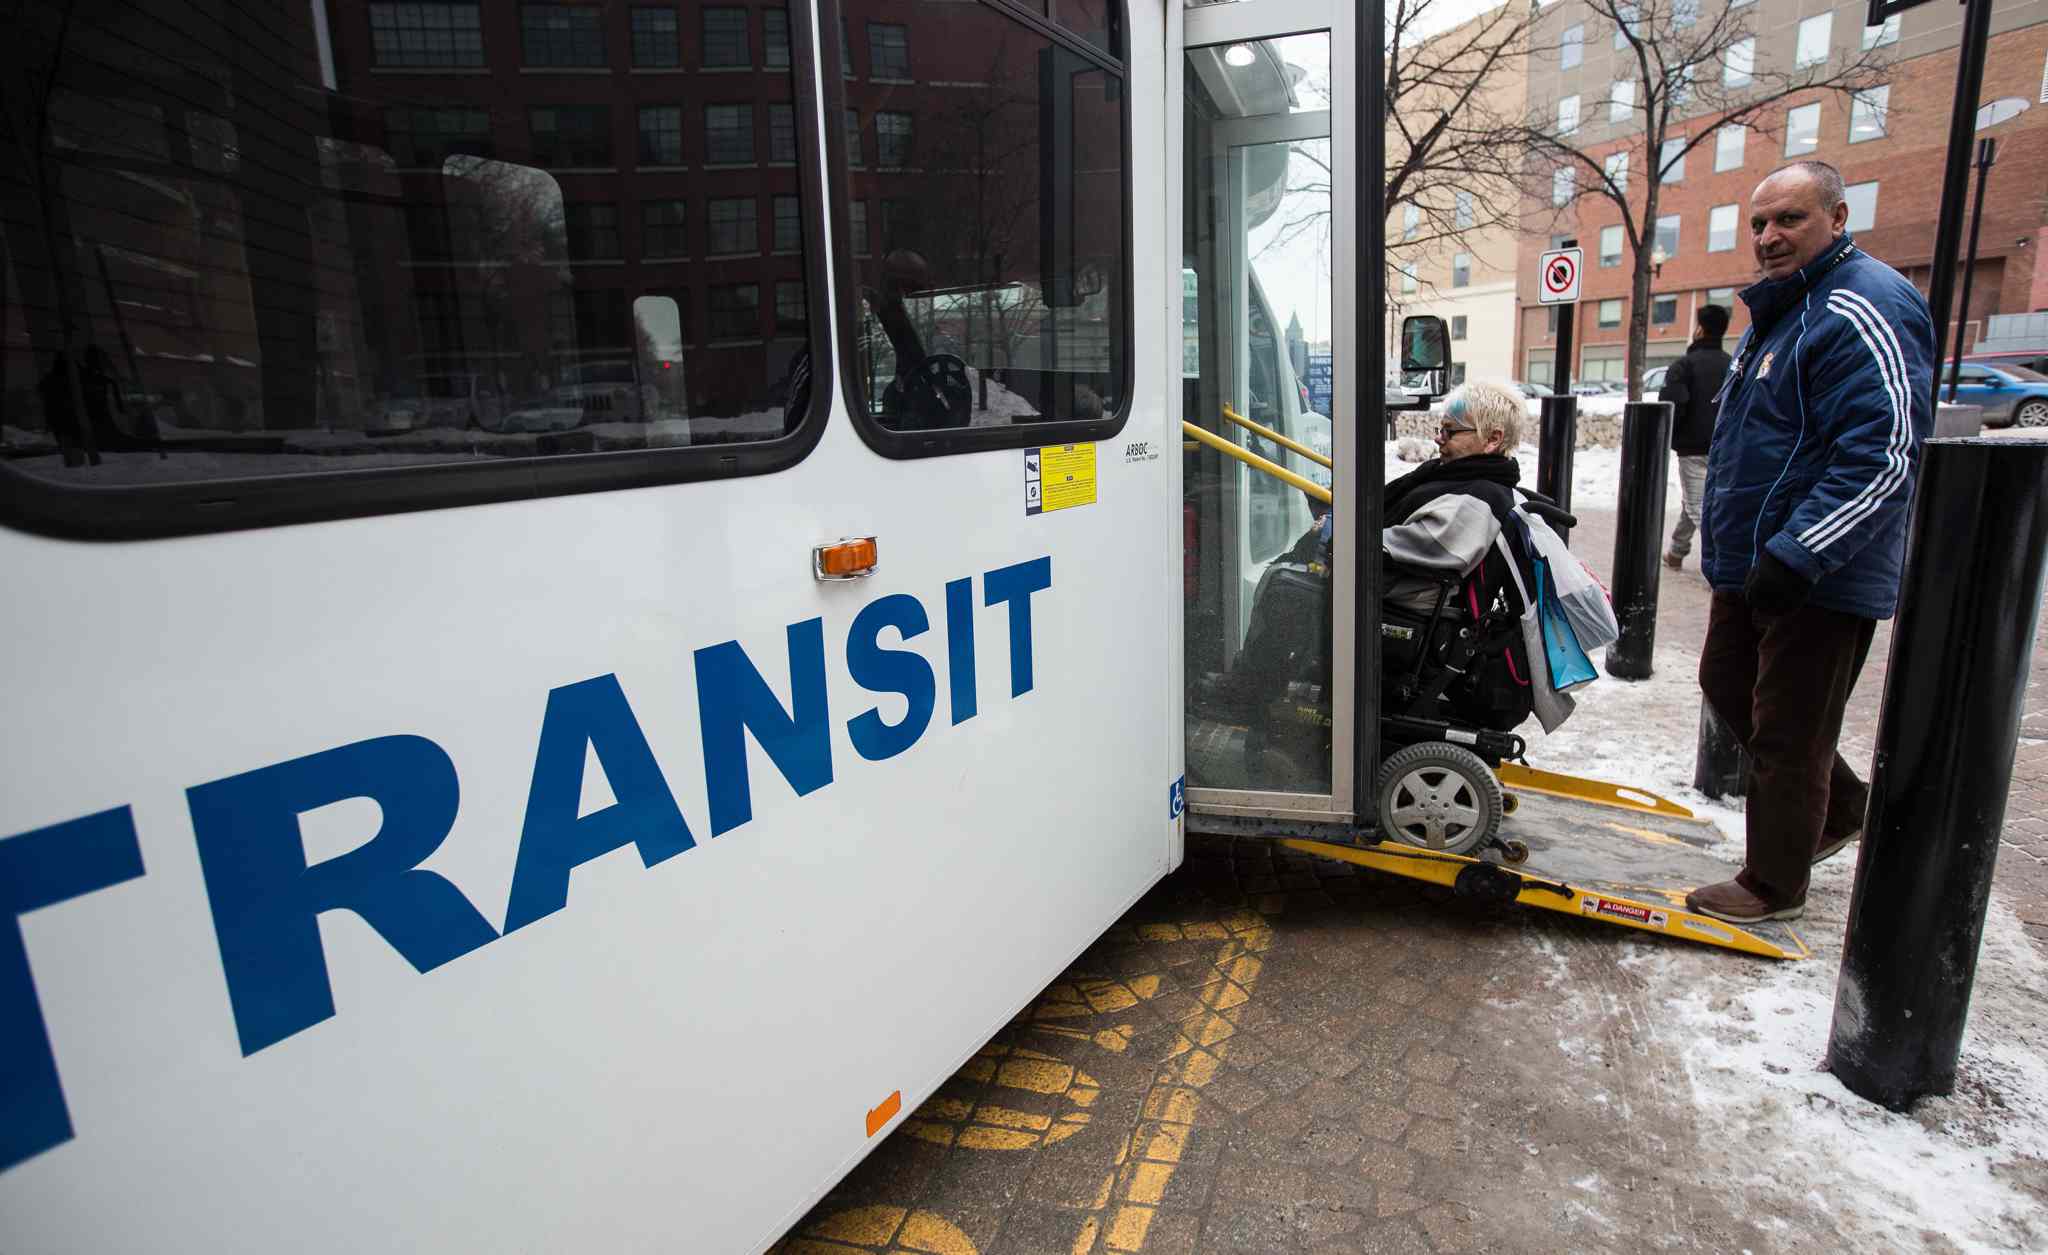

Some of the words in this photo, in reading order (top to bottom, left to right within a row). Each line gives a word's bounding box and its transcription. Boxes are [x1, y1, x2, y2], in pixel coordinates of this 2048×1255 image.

[1125, 442, 1148, 457] ARBOC
[0, 556, 1052, 1173] TRANSIT
[1612, 904, 1646, 916] DANGER
